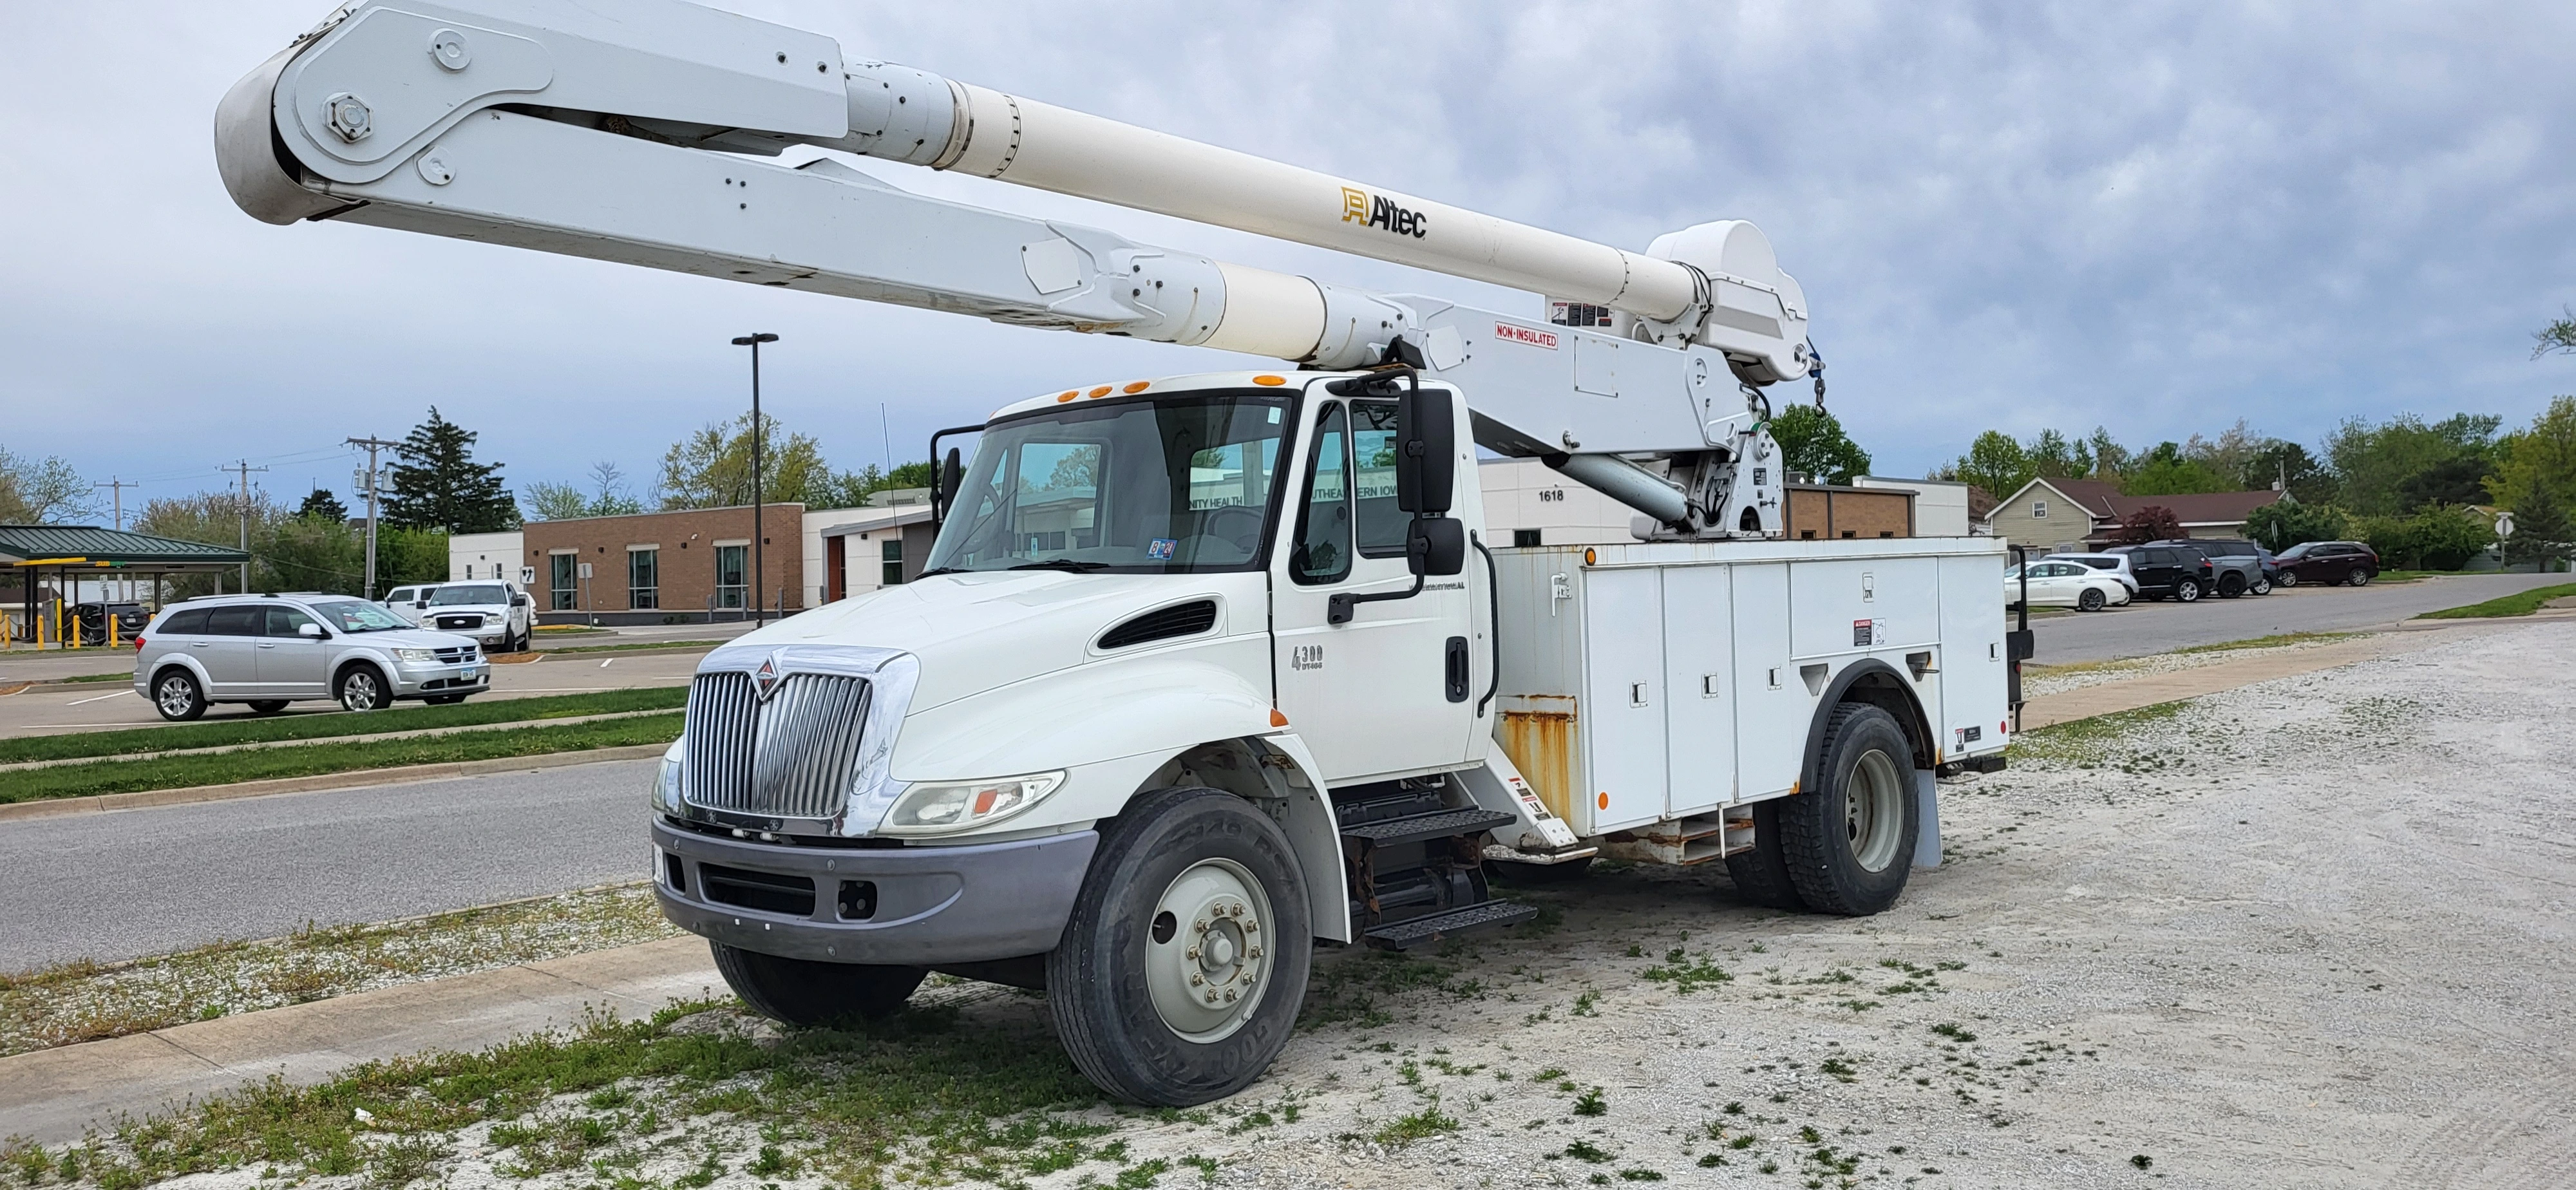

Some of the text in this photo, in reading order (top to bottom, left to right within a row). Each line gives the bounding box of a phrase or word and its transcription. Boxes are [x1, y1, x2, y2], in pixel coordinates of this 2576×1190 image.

[1368, 195, 1427, 239] Altec
[1497, 325, 1557, 346] NON-INSULATED
[1539, 489, 1564, 502] 1618
[1151, 542, 1159, 553] 8
[1291, 645, 1323, 671] 4300
